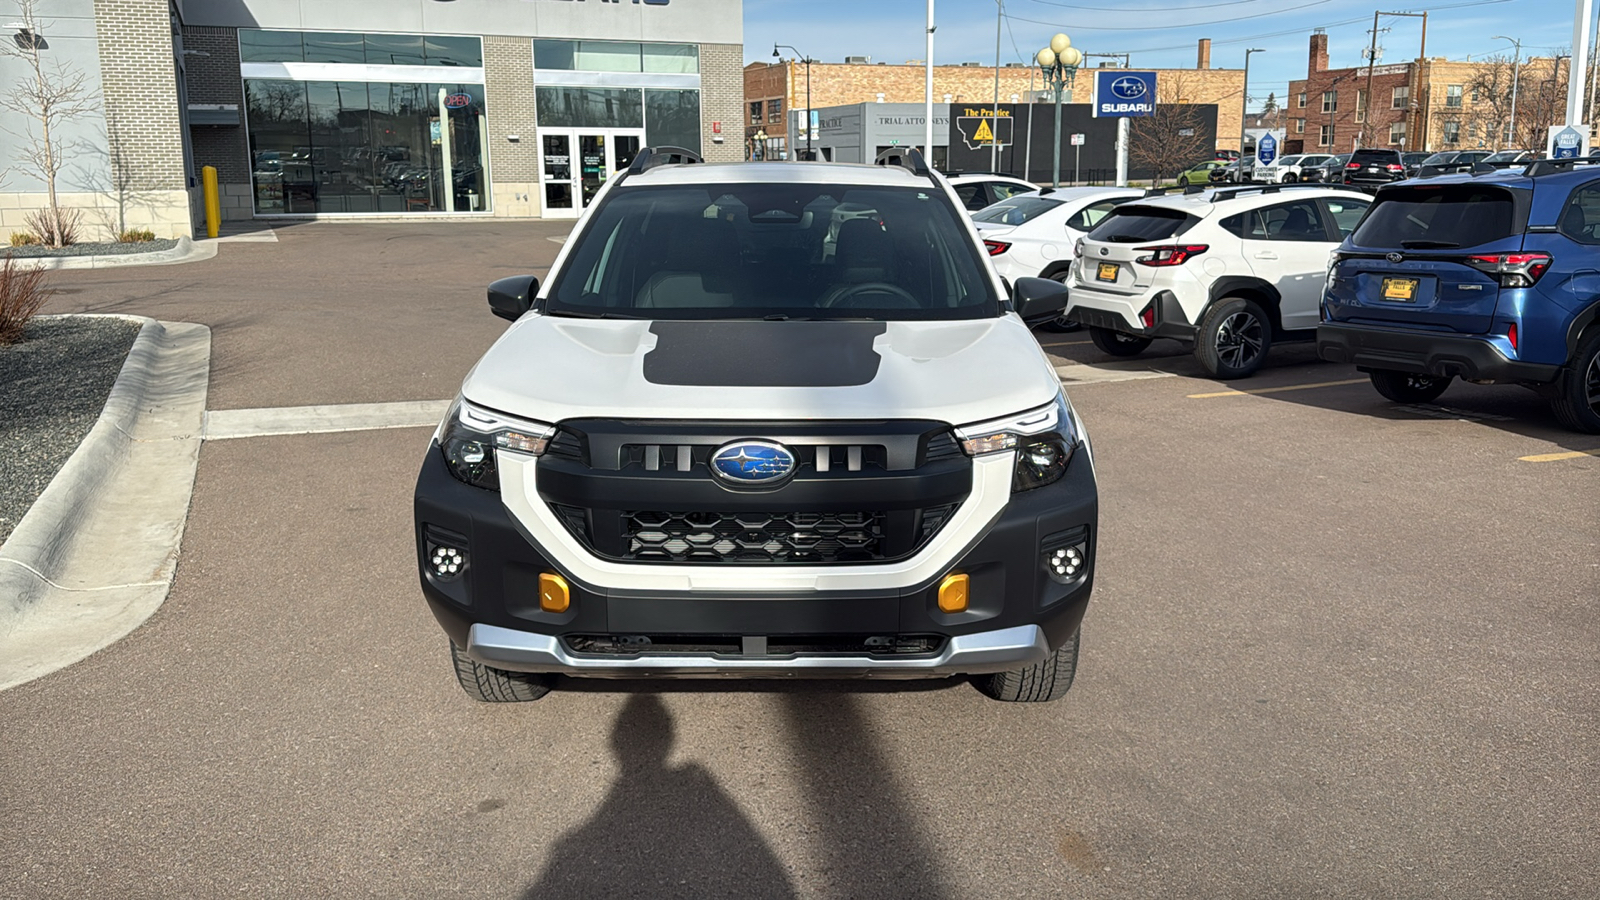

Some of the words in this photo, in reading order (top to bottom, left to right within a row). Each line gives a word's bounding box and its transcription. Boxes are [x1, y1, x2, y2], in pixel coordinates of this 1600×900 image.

[445, 95, 469, 106] OPEN
[1101, 103, 1152, 112] SUBARU
[964, 108, 979, 116] The
[980, 108, 1010, 117] Pratice
[880, 117, 903, 125] TRIAL
[904, 117, 949, 125] ATTONEYS
